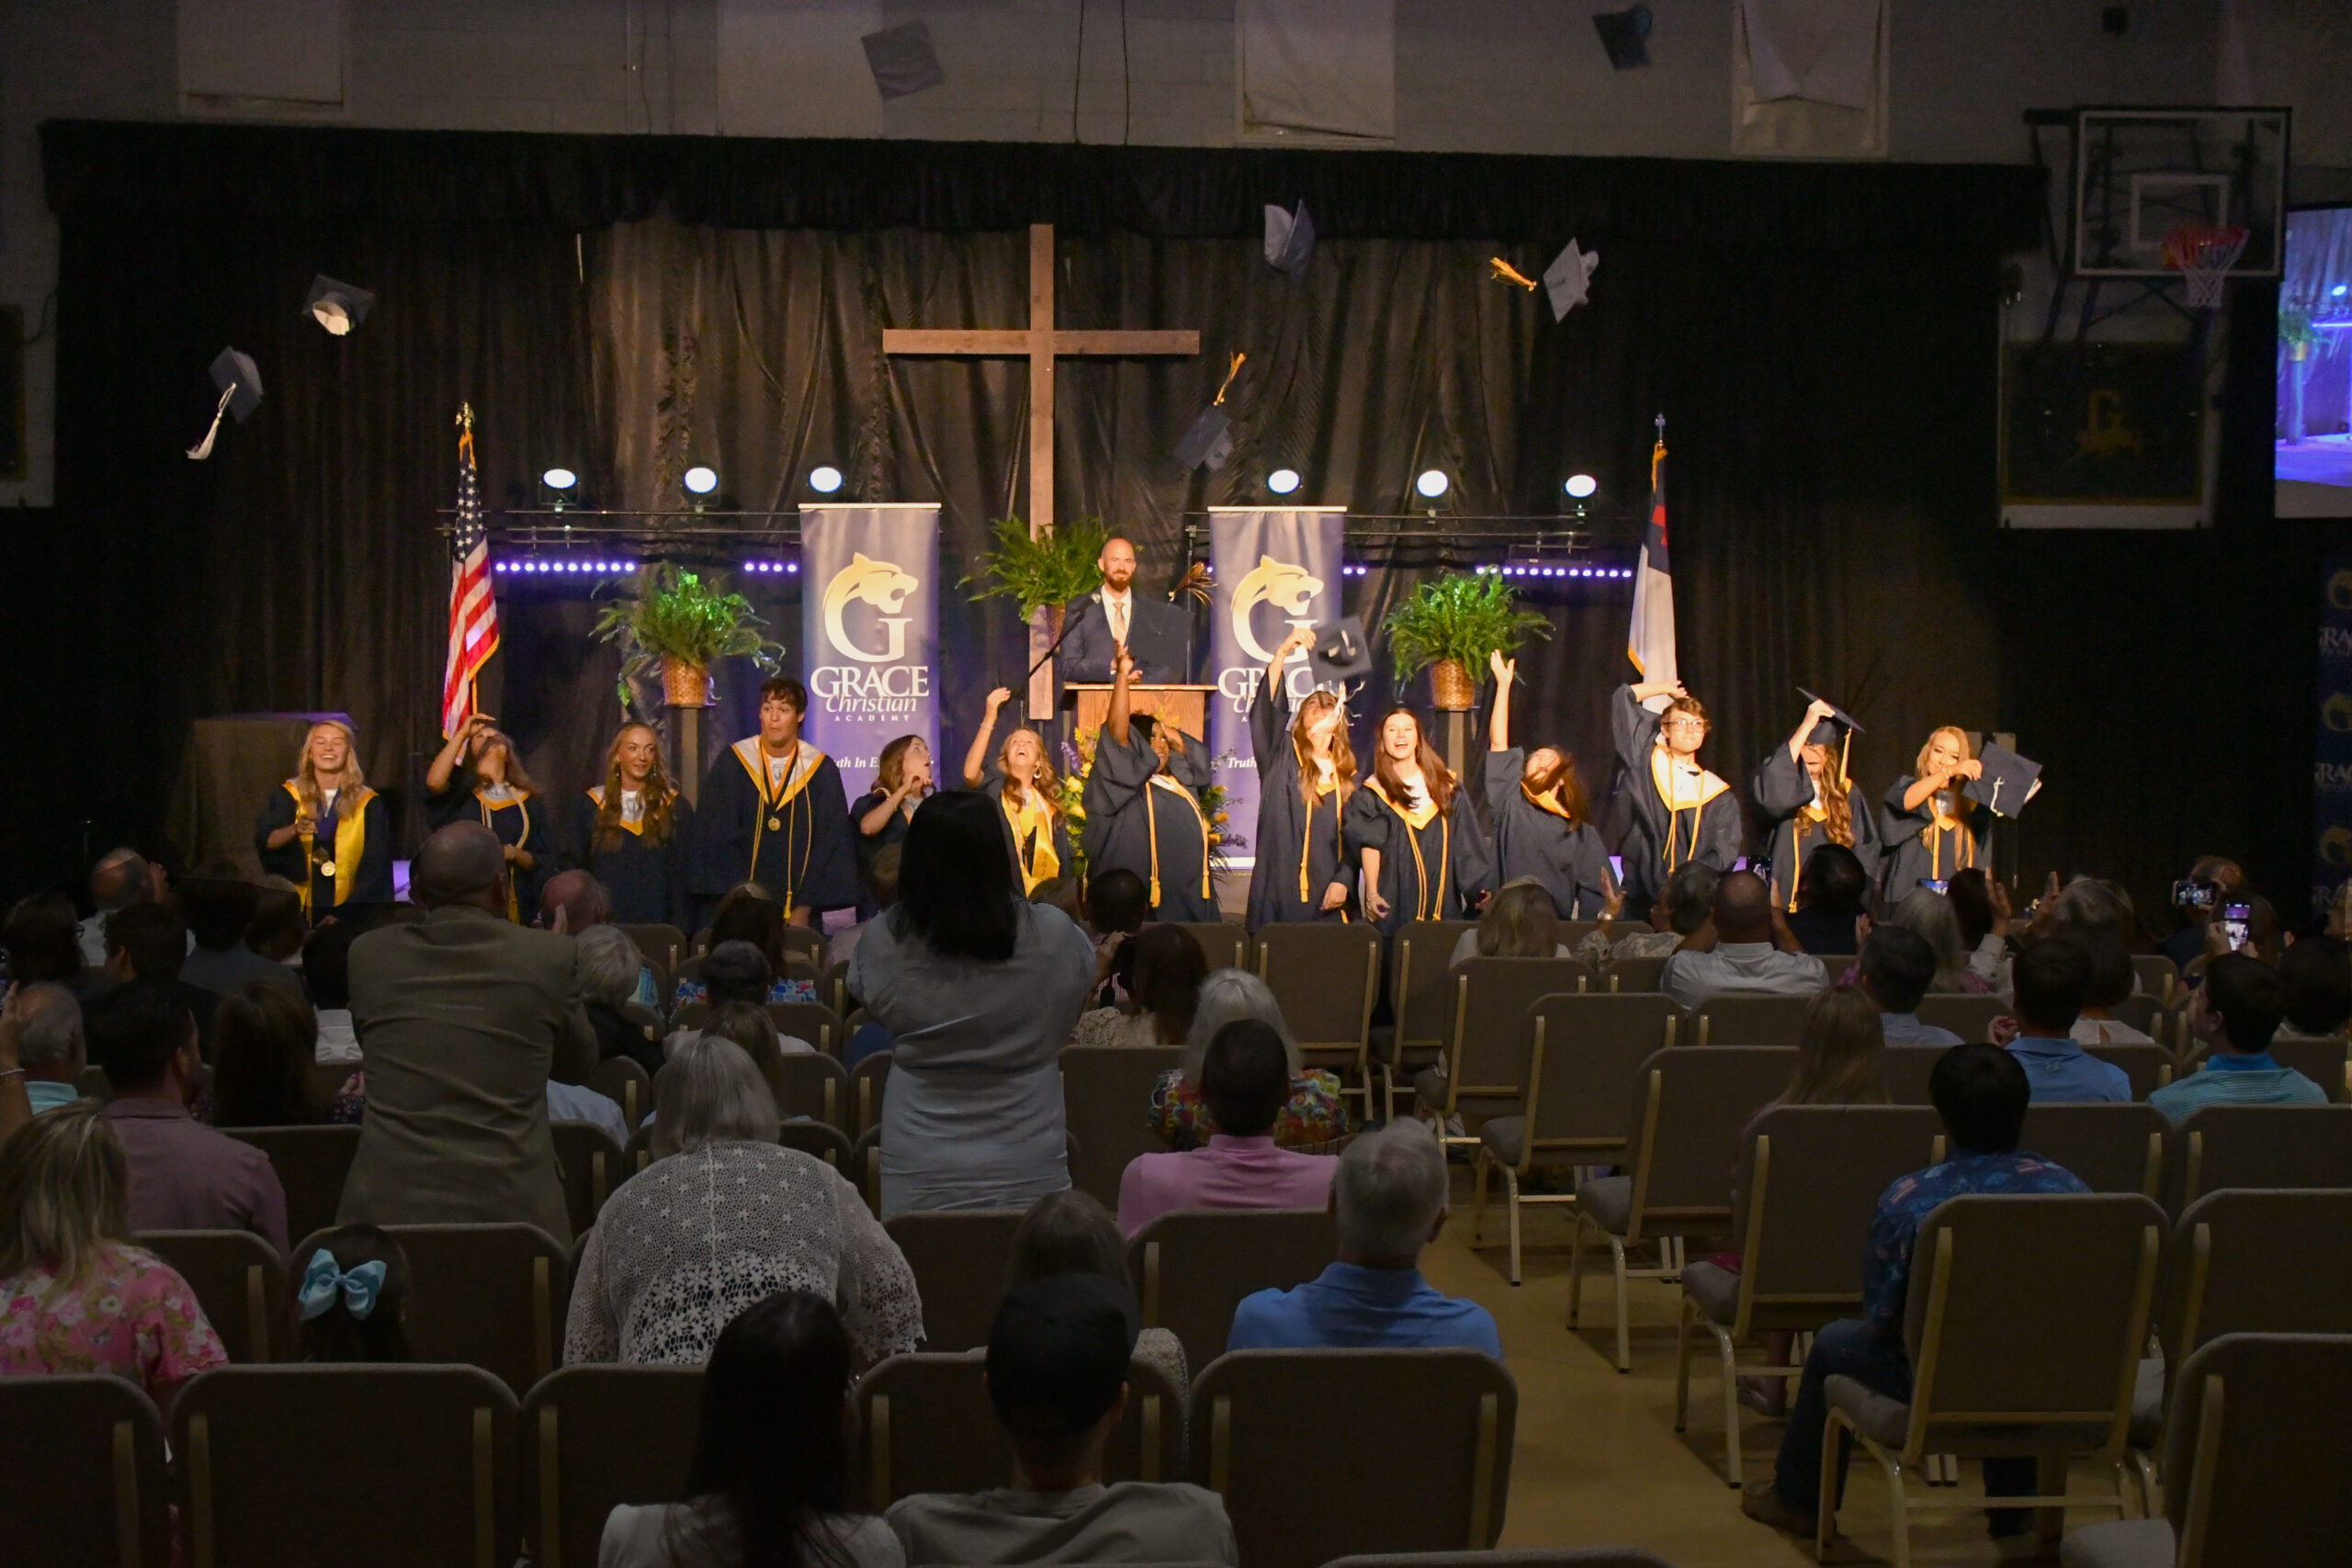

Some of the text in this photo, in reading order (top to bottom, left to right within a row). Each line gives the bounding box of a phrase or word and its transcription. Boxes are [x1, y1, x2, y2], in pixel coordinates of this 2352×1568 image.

[810, 665, 930, 698] GRACE
[826, 693, 917, 713] Christian
[854, 757, 866, 768] In
[1227, 756, 1258, 768] Truth
